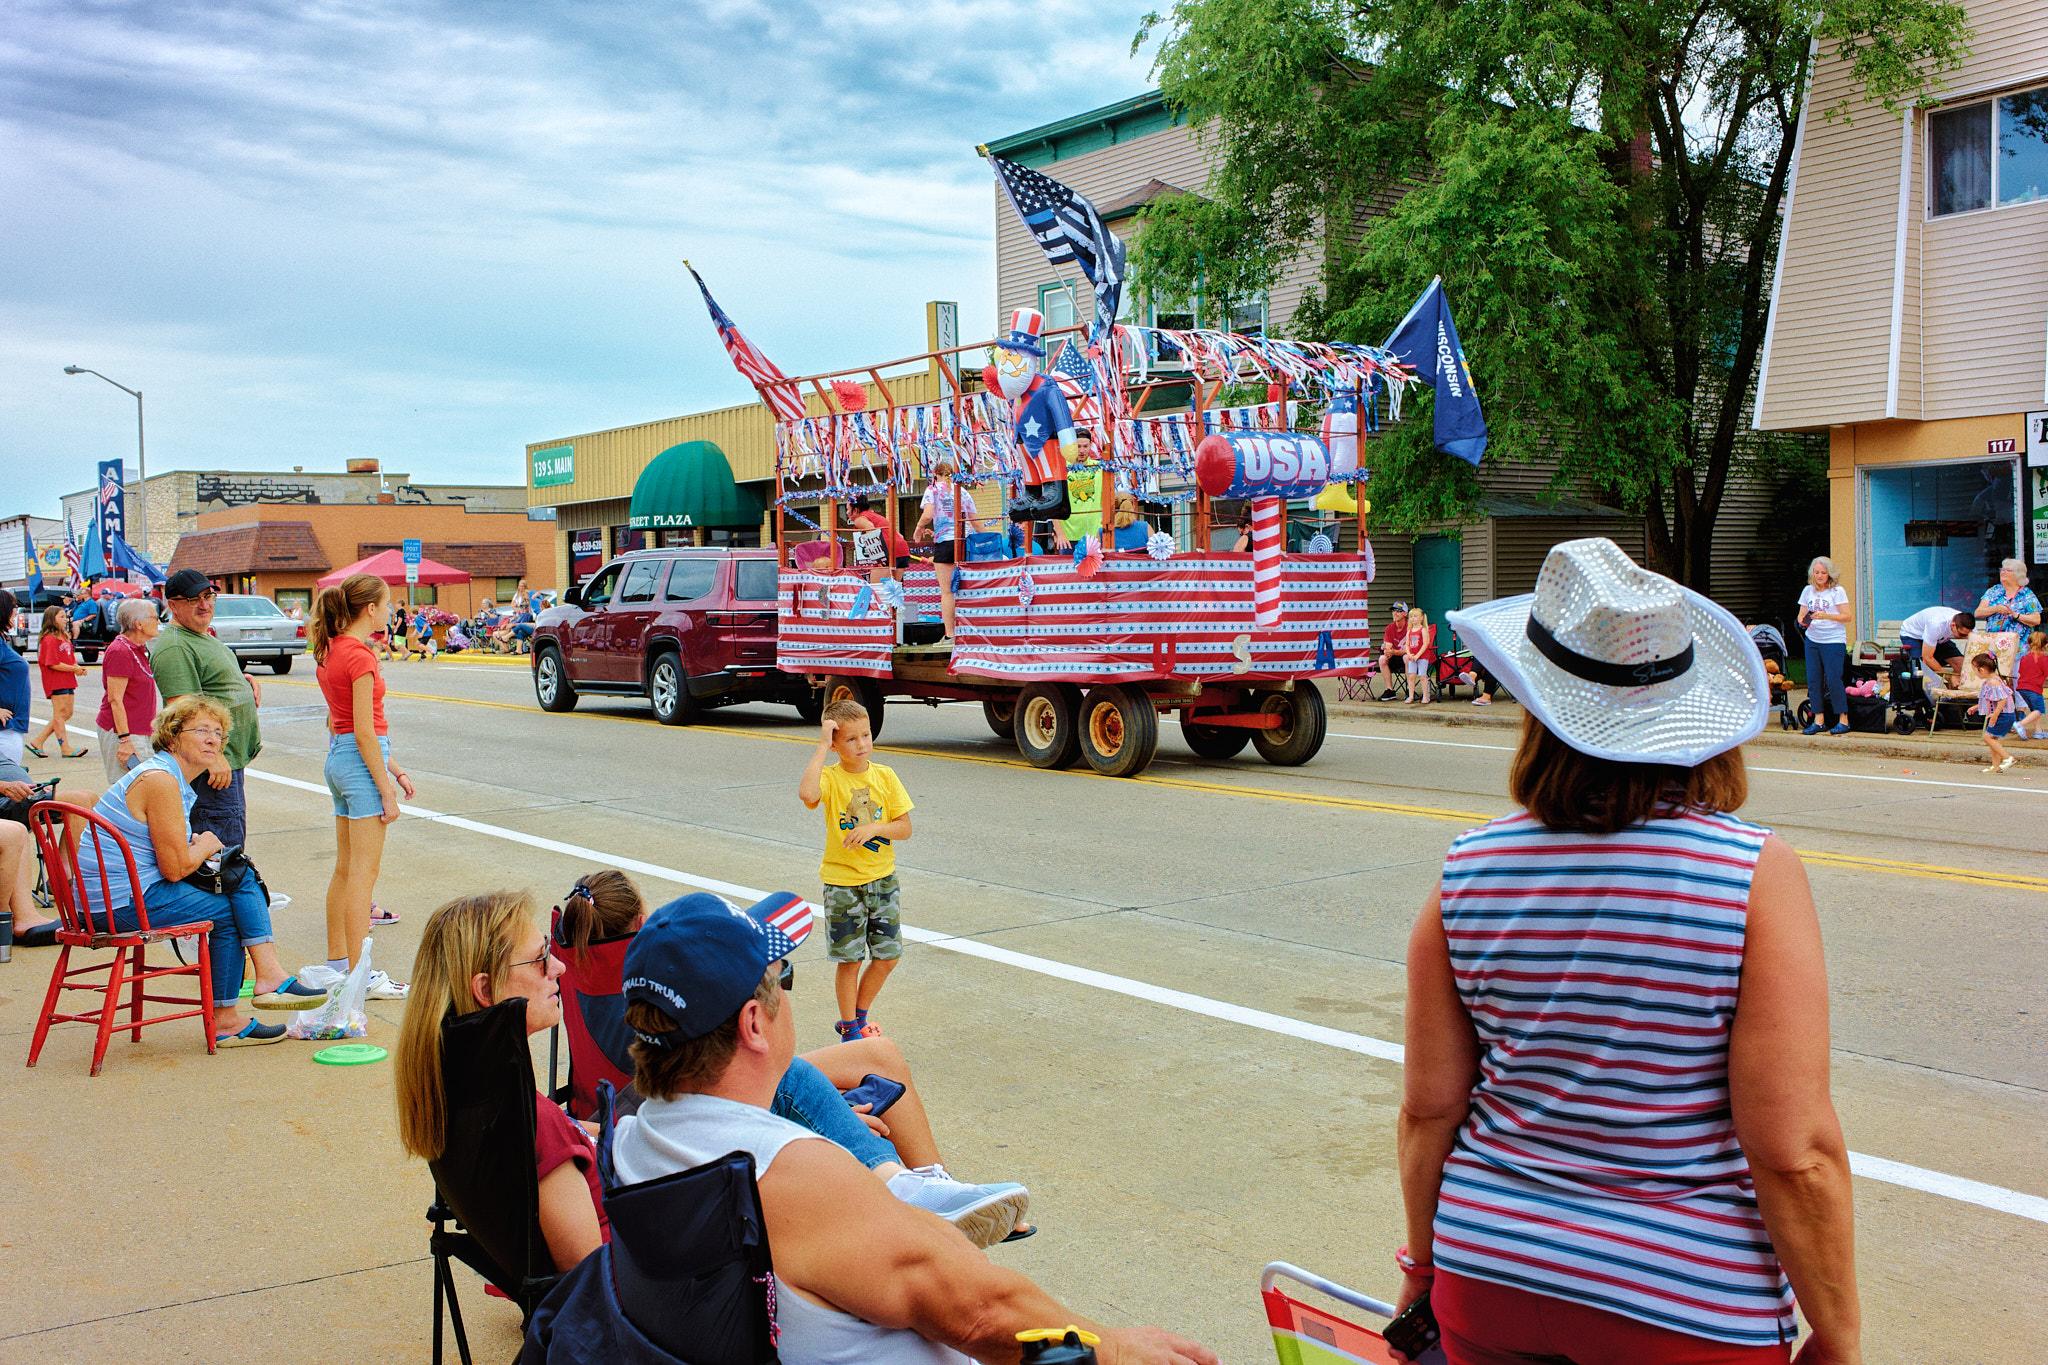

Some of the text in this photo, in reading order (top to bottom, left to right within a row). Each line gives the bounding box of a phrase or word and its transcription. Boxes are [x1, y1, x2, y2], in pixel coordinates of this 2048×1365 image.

[942, 305, 951, 340] MAIN
[1990, 440, 2012, 452] 117
[535, 455, 572, 477] 139 S. MAIN
[1236, 437, 1327, 484] USA
[653, 514, 692, 526] PLAZA
[648, 980, 686, 1009] TRUMP
